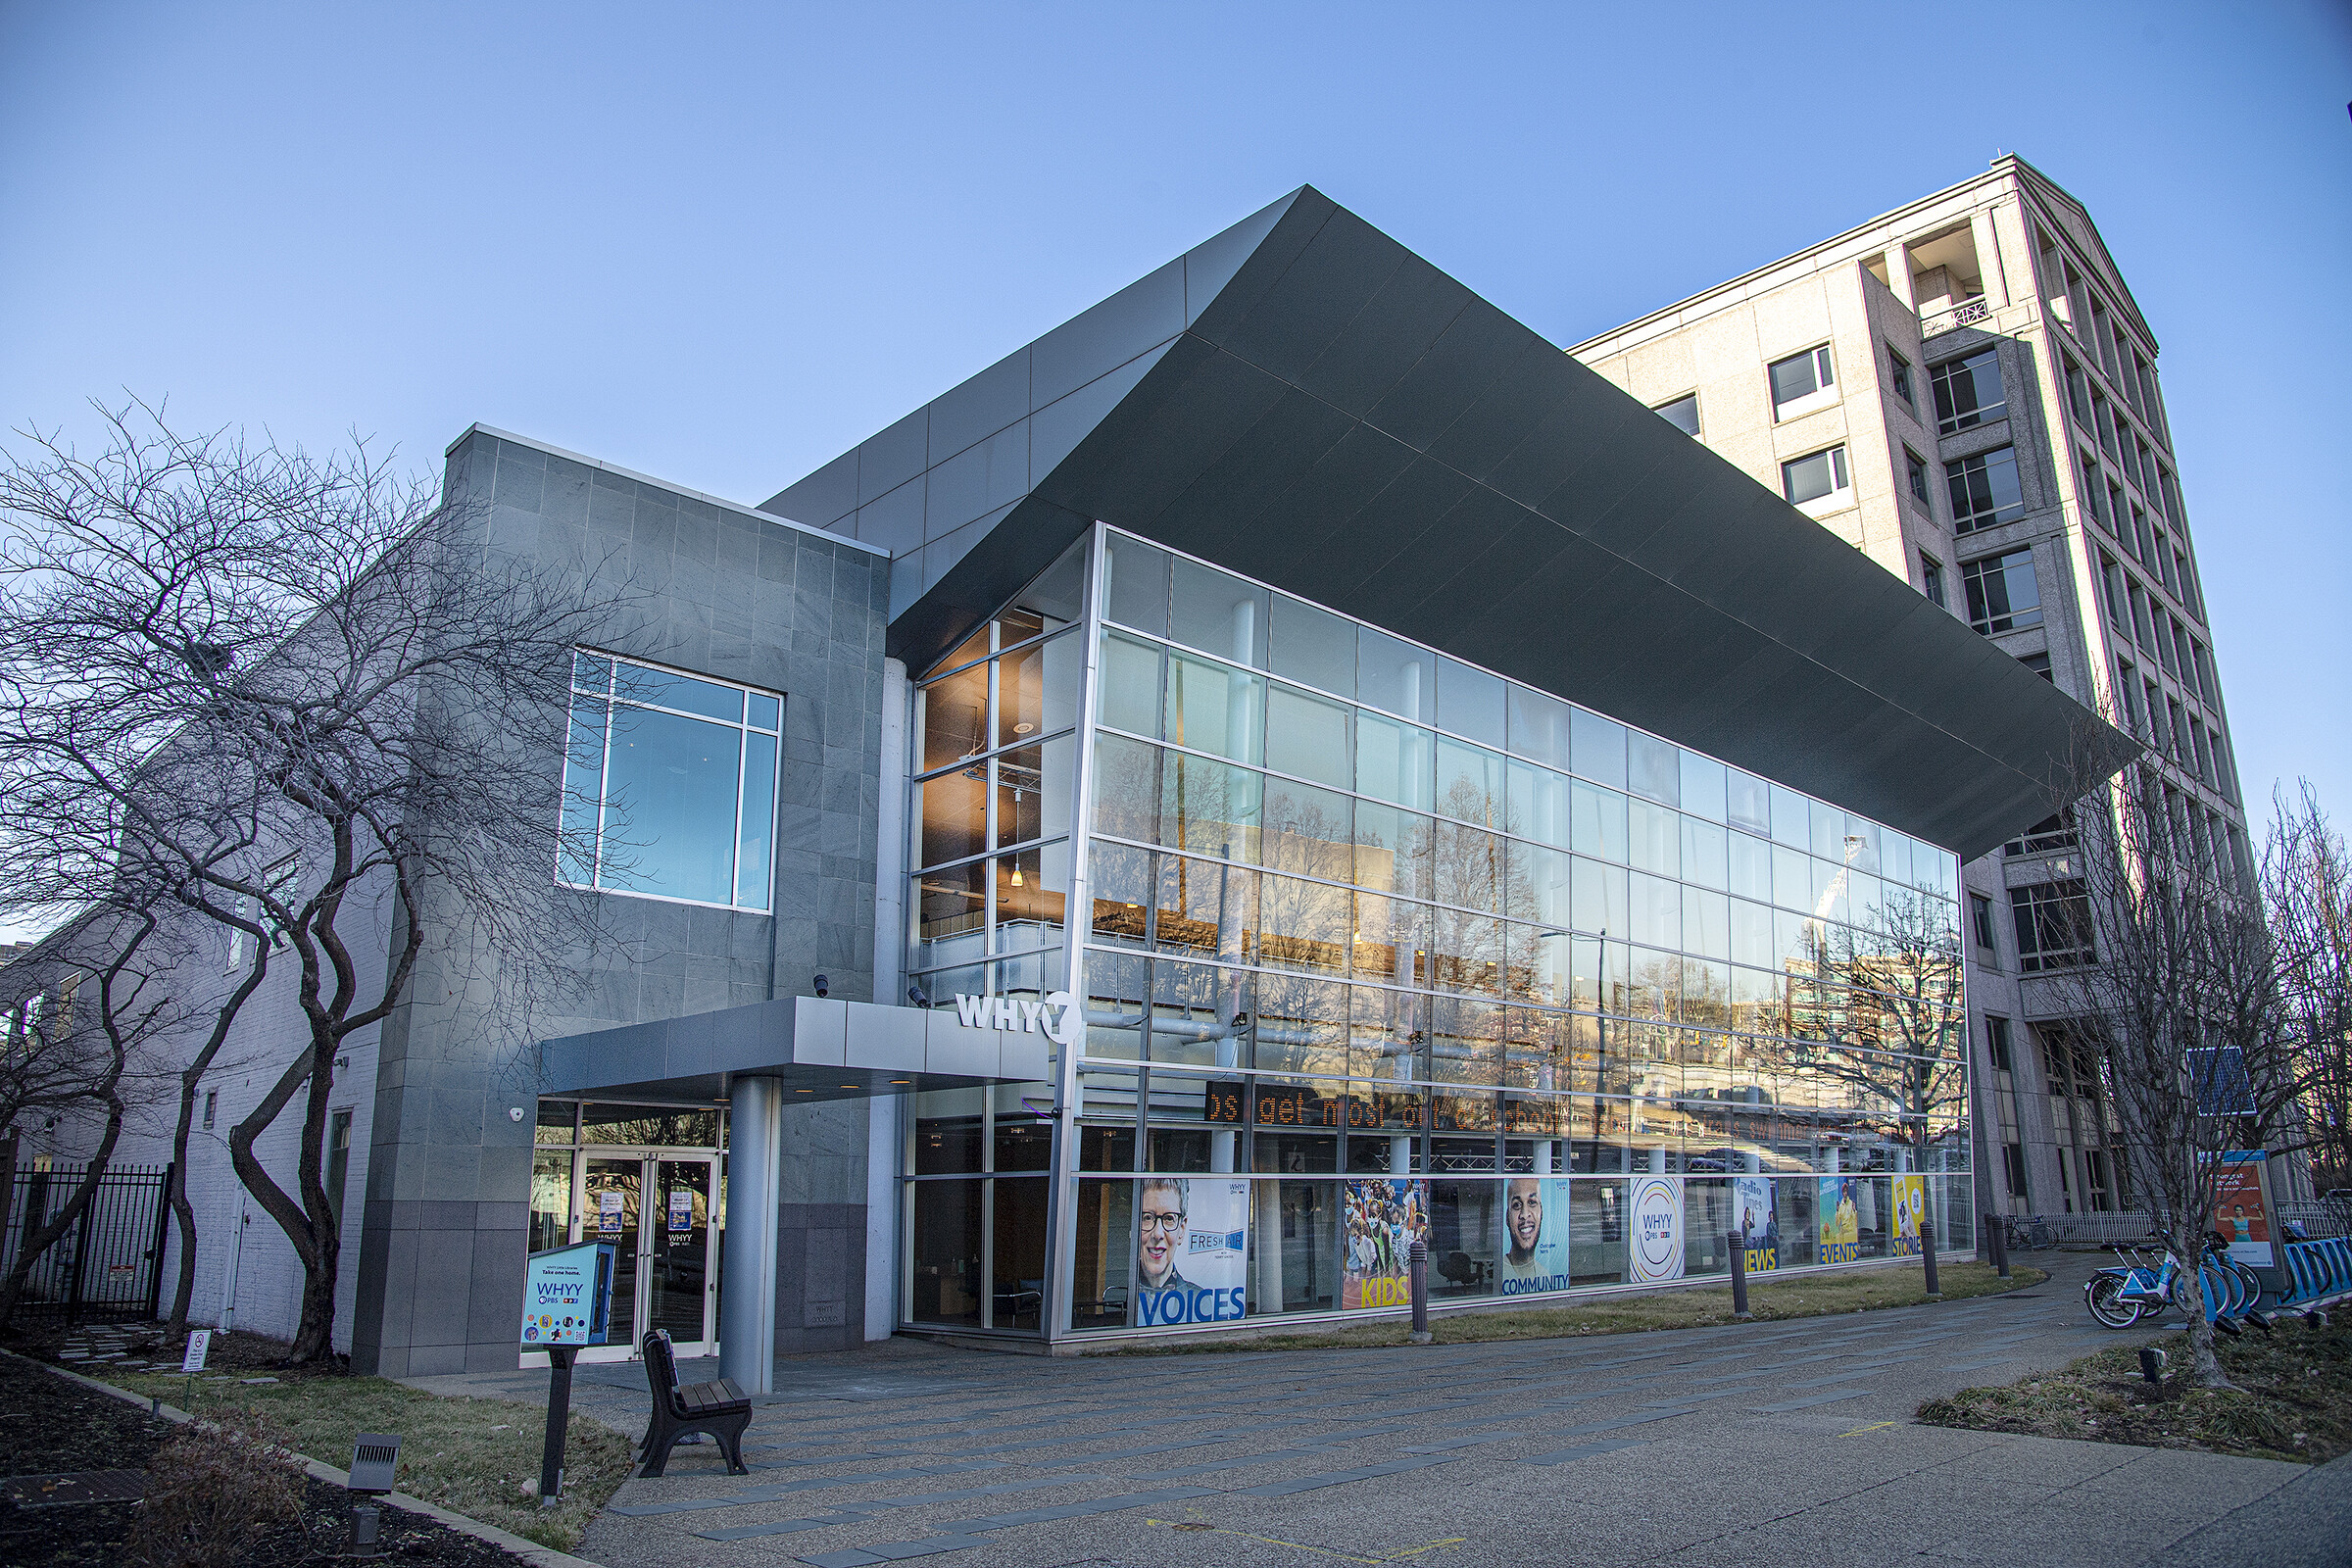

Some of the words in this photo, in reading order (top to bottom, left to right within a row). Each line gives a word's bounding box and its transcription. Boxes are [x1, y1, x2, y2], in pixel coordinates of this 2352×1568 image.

[956, 991, 1082, 1043] WHYY
[1259, 1093, 1303, 1124] get
[1323, 1097, 1386, 1127] most
[1643, 1213, 1672, 1229] WHYY
[1190, 1235, 1223, 1250] FRESH
[1227, 1234, 1242, 1248] AIR
[1821, 1243, 1859, 1264] EVENTS
[537, 1283, 583, 1296] WHYY
[1361, 1276, 1408, 1308] KIDS
[1502, 1274, 1569, 1296] COMMUNITY
[1139, 1287, 1245, 1326] VOICES
